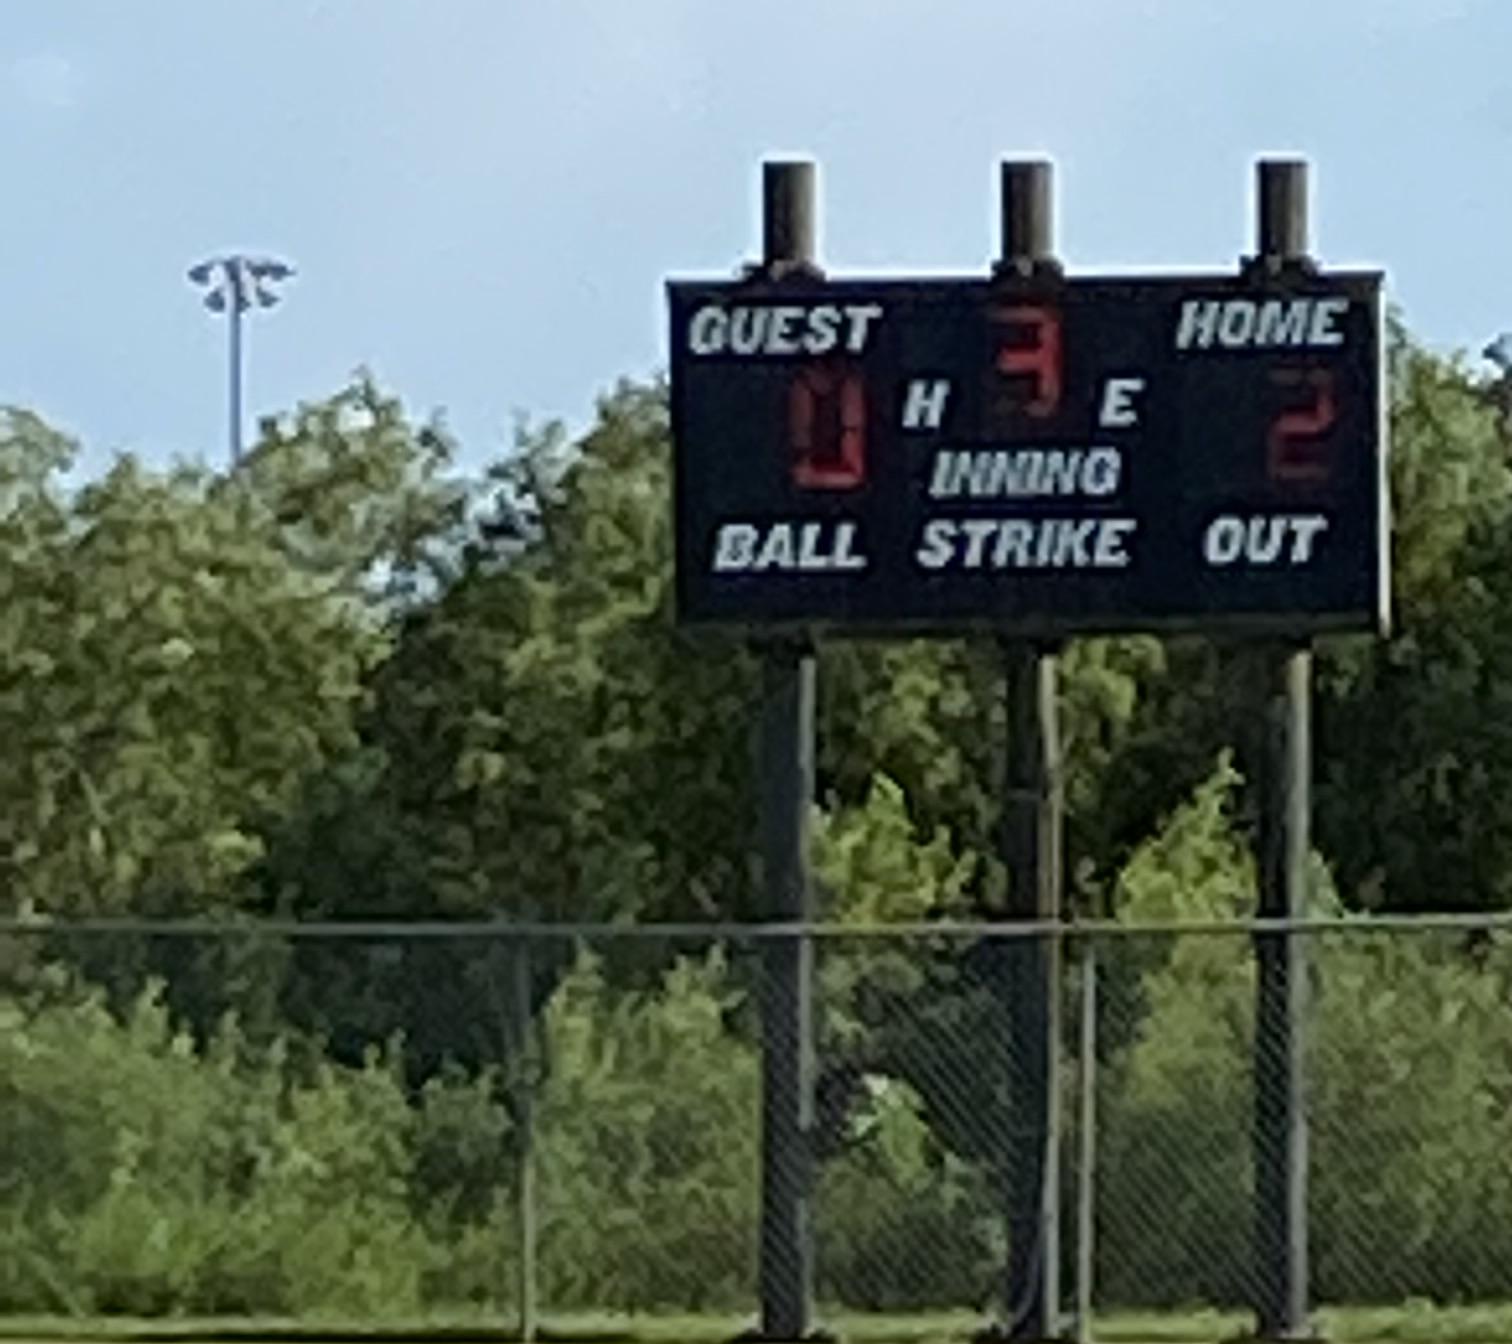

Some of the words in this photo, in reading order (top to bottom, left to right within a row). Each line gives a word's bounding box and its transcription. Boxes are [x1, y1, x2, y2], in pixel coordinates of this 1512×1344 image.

[689, 305, 882, 354] GUEST
[1177, 300, 1349, 349] HOME
[990, 305, 1062, 418] 3
[903, 381, 950, 428] H
[1100, 379, 1146, 426] E
[1267, 368, 1336, 480] 2
[929, 448, 1121, 498] INNING
[712, 524, 867, 571] BALL
[917, 519, 1137, 568] STRIKE
[1204, 516, 1327, 563] OUT
